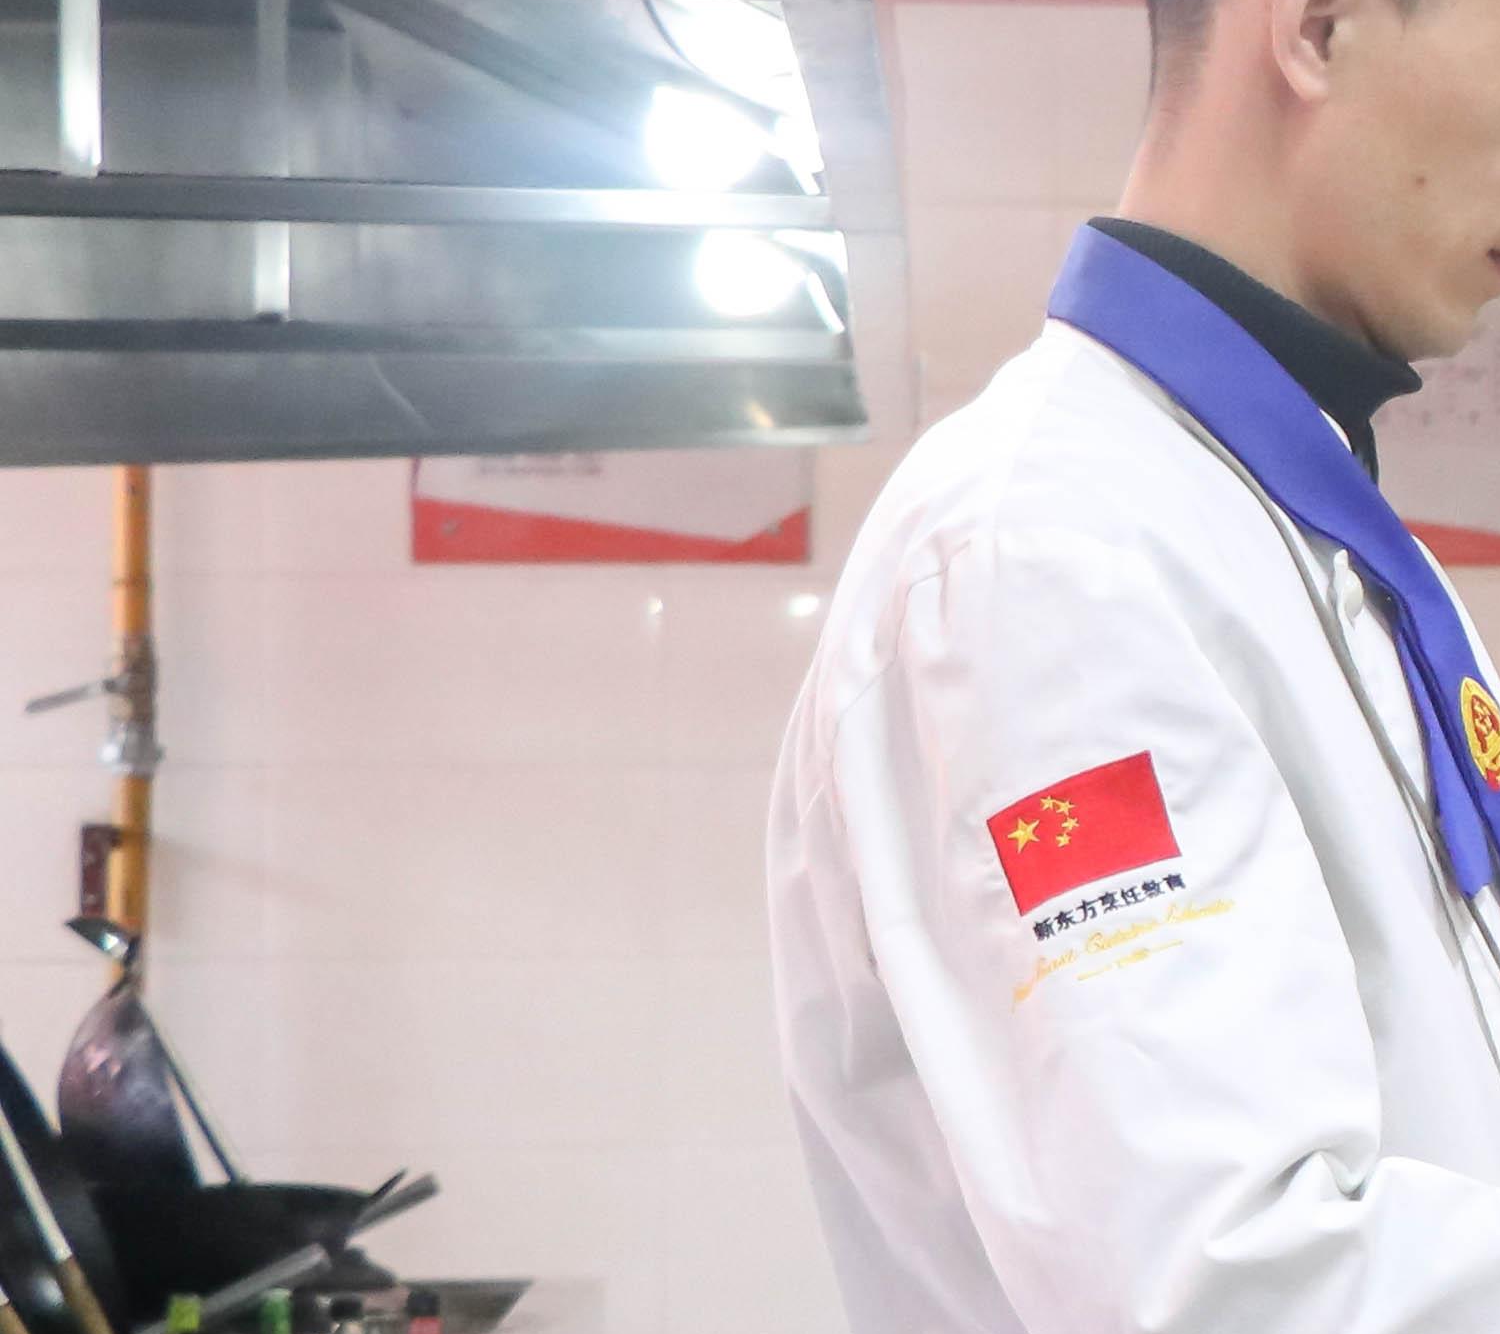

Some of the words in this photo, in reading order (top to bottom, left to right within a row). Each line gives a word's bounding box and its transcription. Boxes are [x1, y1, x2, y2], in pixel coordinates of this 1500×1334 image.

[1033, 873, 1187, 942] 新东方烹饪教育
